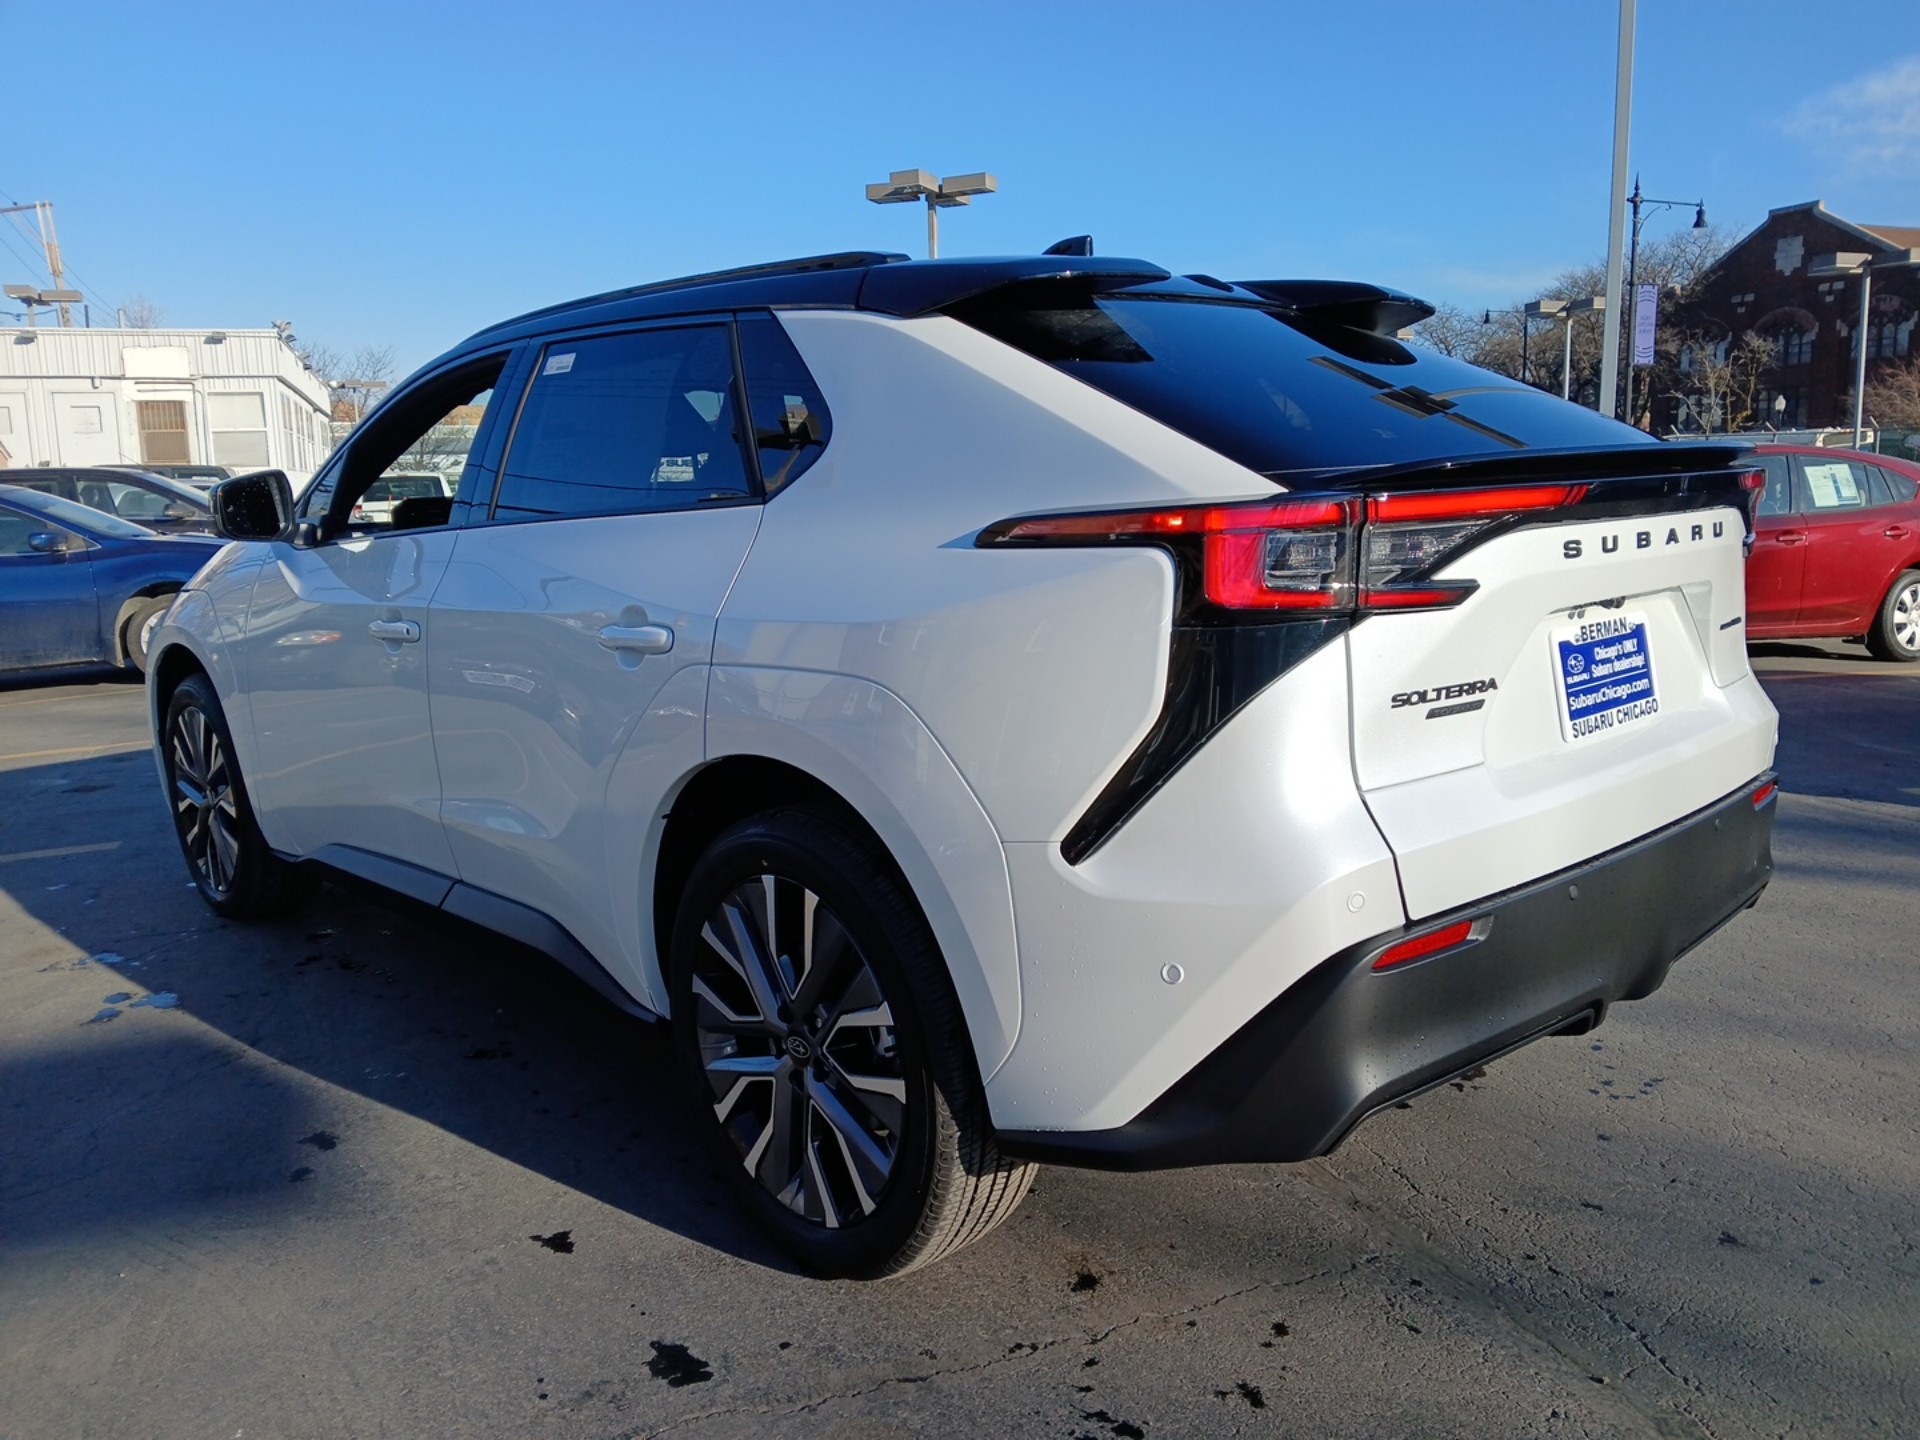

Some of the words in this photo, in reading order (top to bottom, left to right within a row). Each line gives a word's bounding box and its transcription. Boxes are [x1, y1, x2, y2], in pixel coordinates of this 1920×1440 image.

[1563, 521, 1723, 559] SUBARU
[1580, 617, 1628, 642] BERMAN
[1391, 677, 1498, 708] SOLTERRA
[1566, 672, 1590, 684] SUBARU
[1569, 678, 1650, 710] SubaruChicago.com
[1572, 711, 1614, 739] SUBARU
[1616, 698, 1659, 724] CHICAGO
